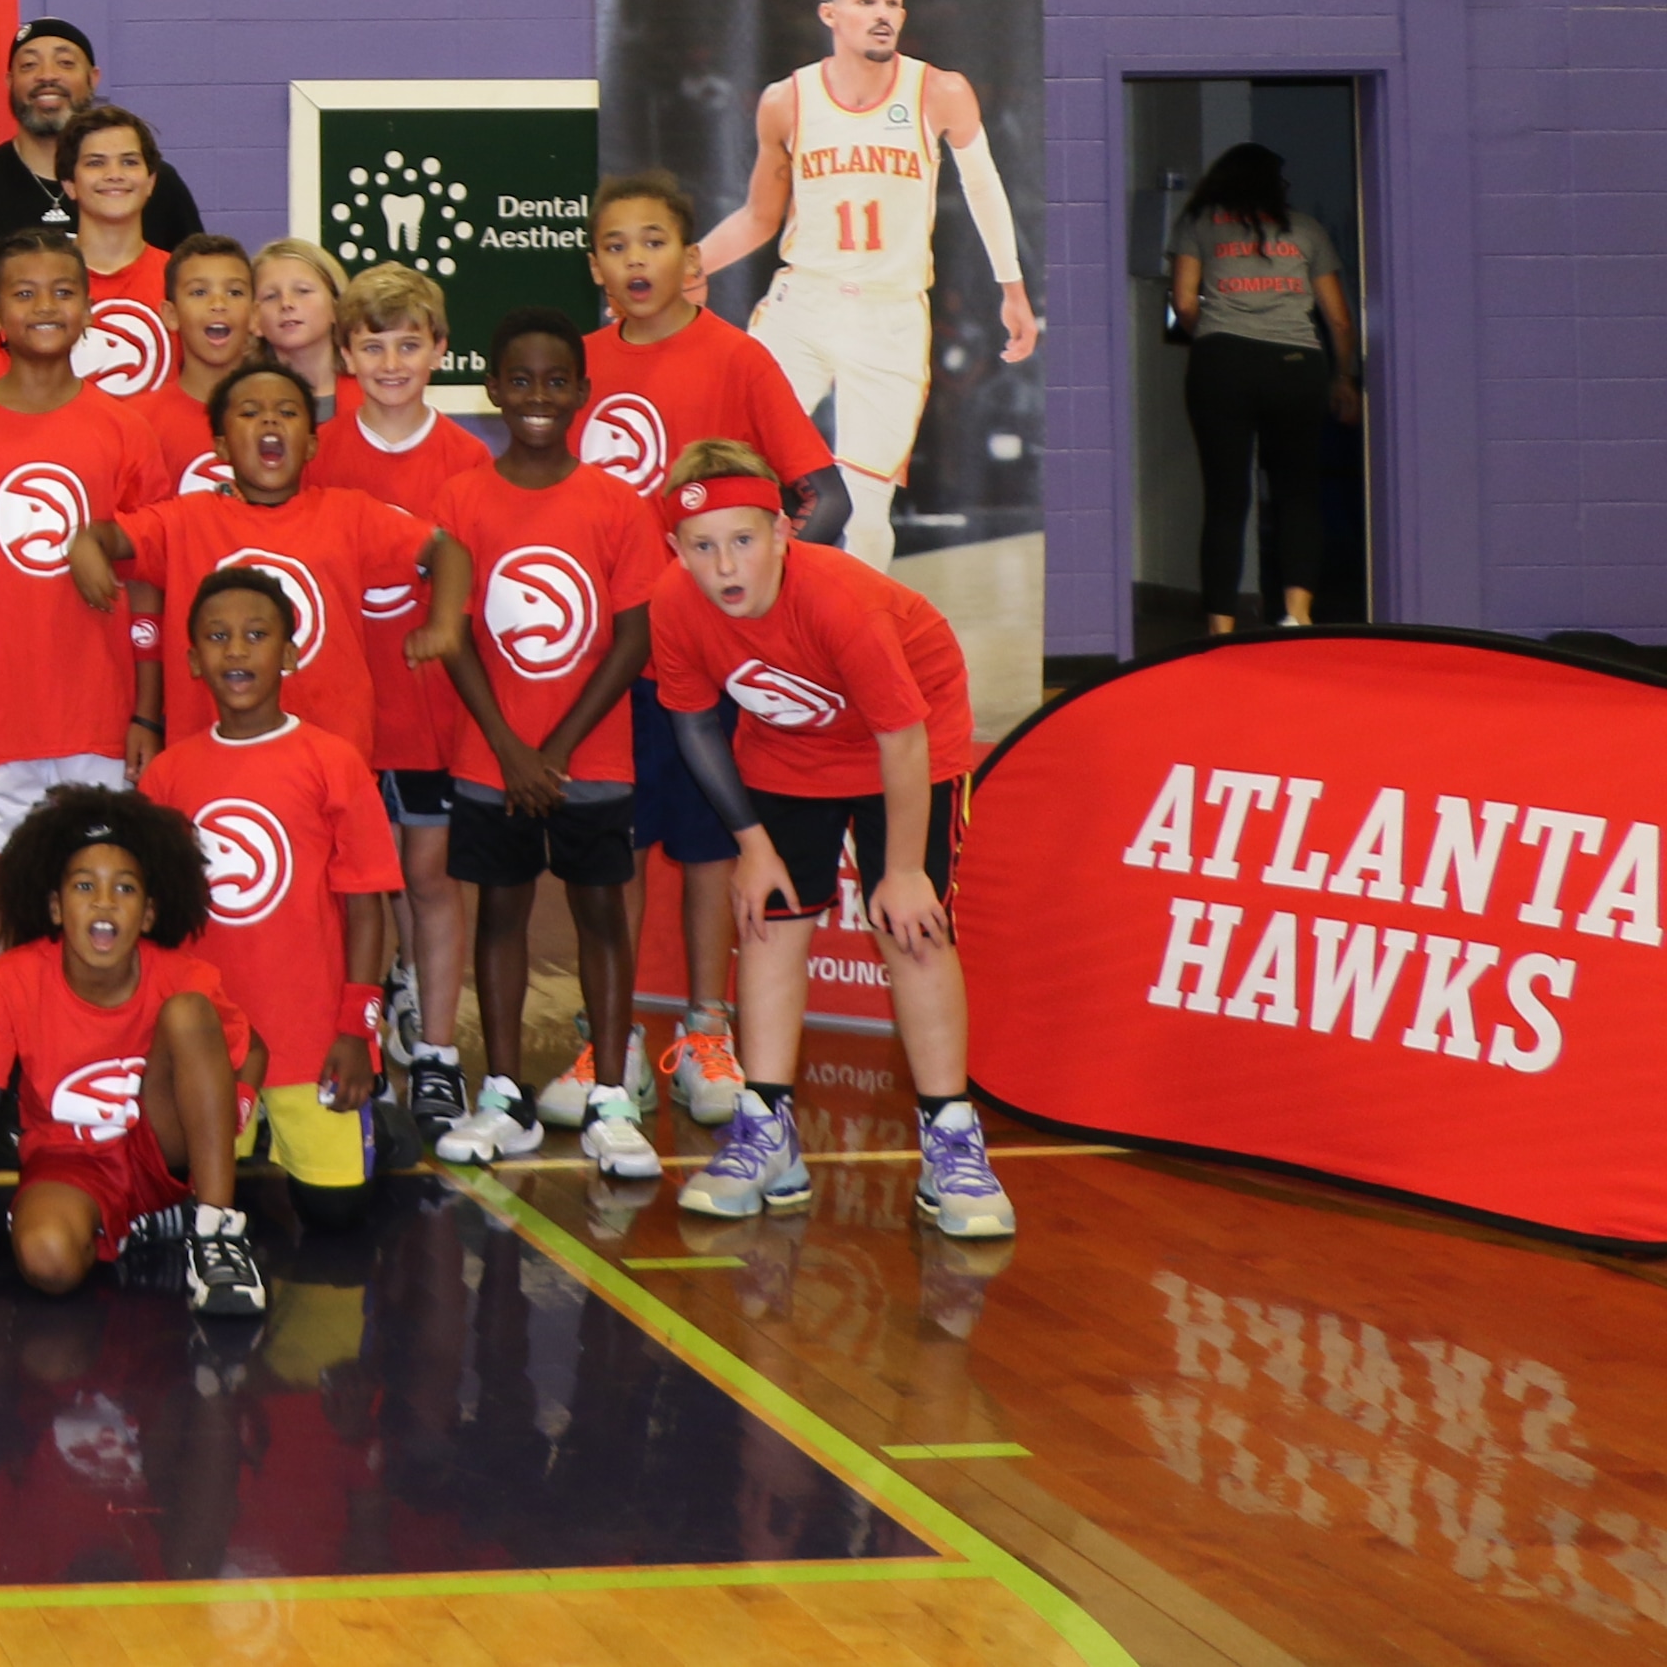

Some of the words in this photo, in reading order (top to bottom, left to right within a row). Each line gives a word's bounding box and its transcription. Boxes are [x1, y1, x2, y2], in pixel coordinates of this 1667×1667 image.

[801, 145, 923, 180] ATLANTA
[498, 195, 588, 218] Dental
[835, 200, 884, 252] 11
[480, 225, 592, 249] Aesthet
[1122, 763, 1664, 947] ATLANTA
[1148, 897, 1577, 1073] HAWKS
